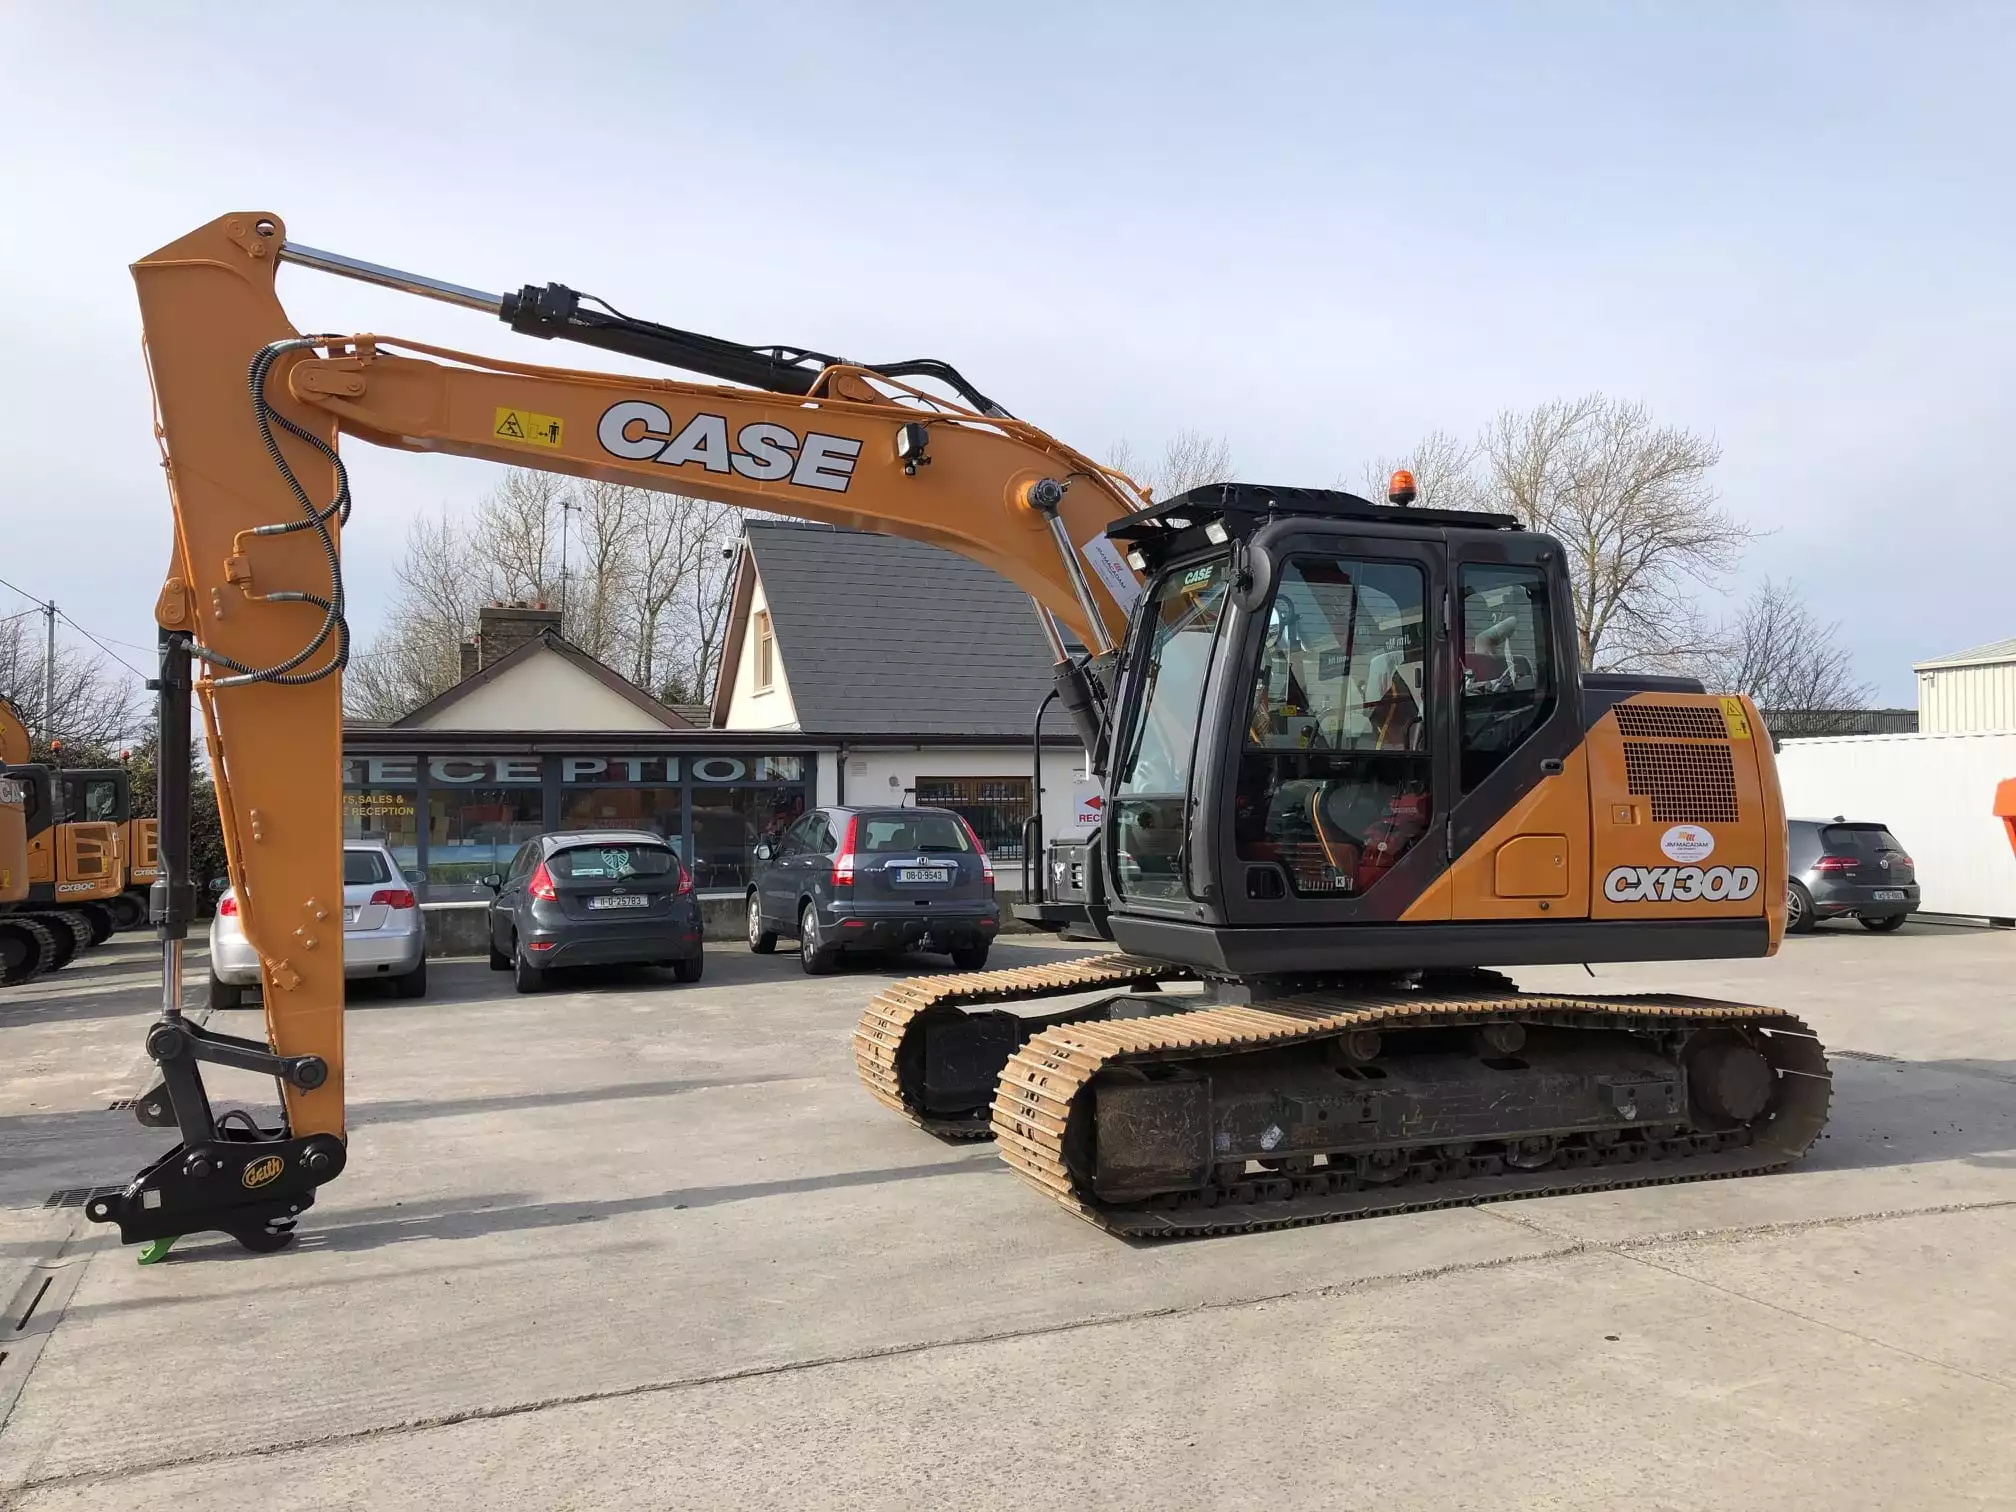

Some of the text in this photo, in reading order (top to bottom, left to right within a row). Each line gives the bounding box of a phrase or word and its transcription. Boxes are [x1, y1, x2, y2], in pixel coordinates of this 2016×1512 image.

[597, 400, 863, 492] CASE
[1184, 565, 1214, 584] CASE
[396, 794, 404, 804] &
[351, 807, 414, 816] RECEPTION
[1079, 814, 1103, 823] REC
[906, 871, 942, 880] 08-D-9543
[58, 882, 96, 892] CX80C
[1603, 866, 1760, 903] CX130D
